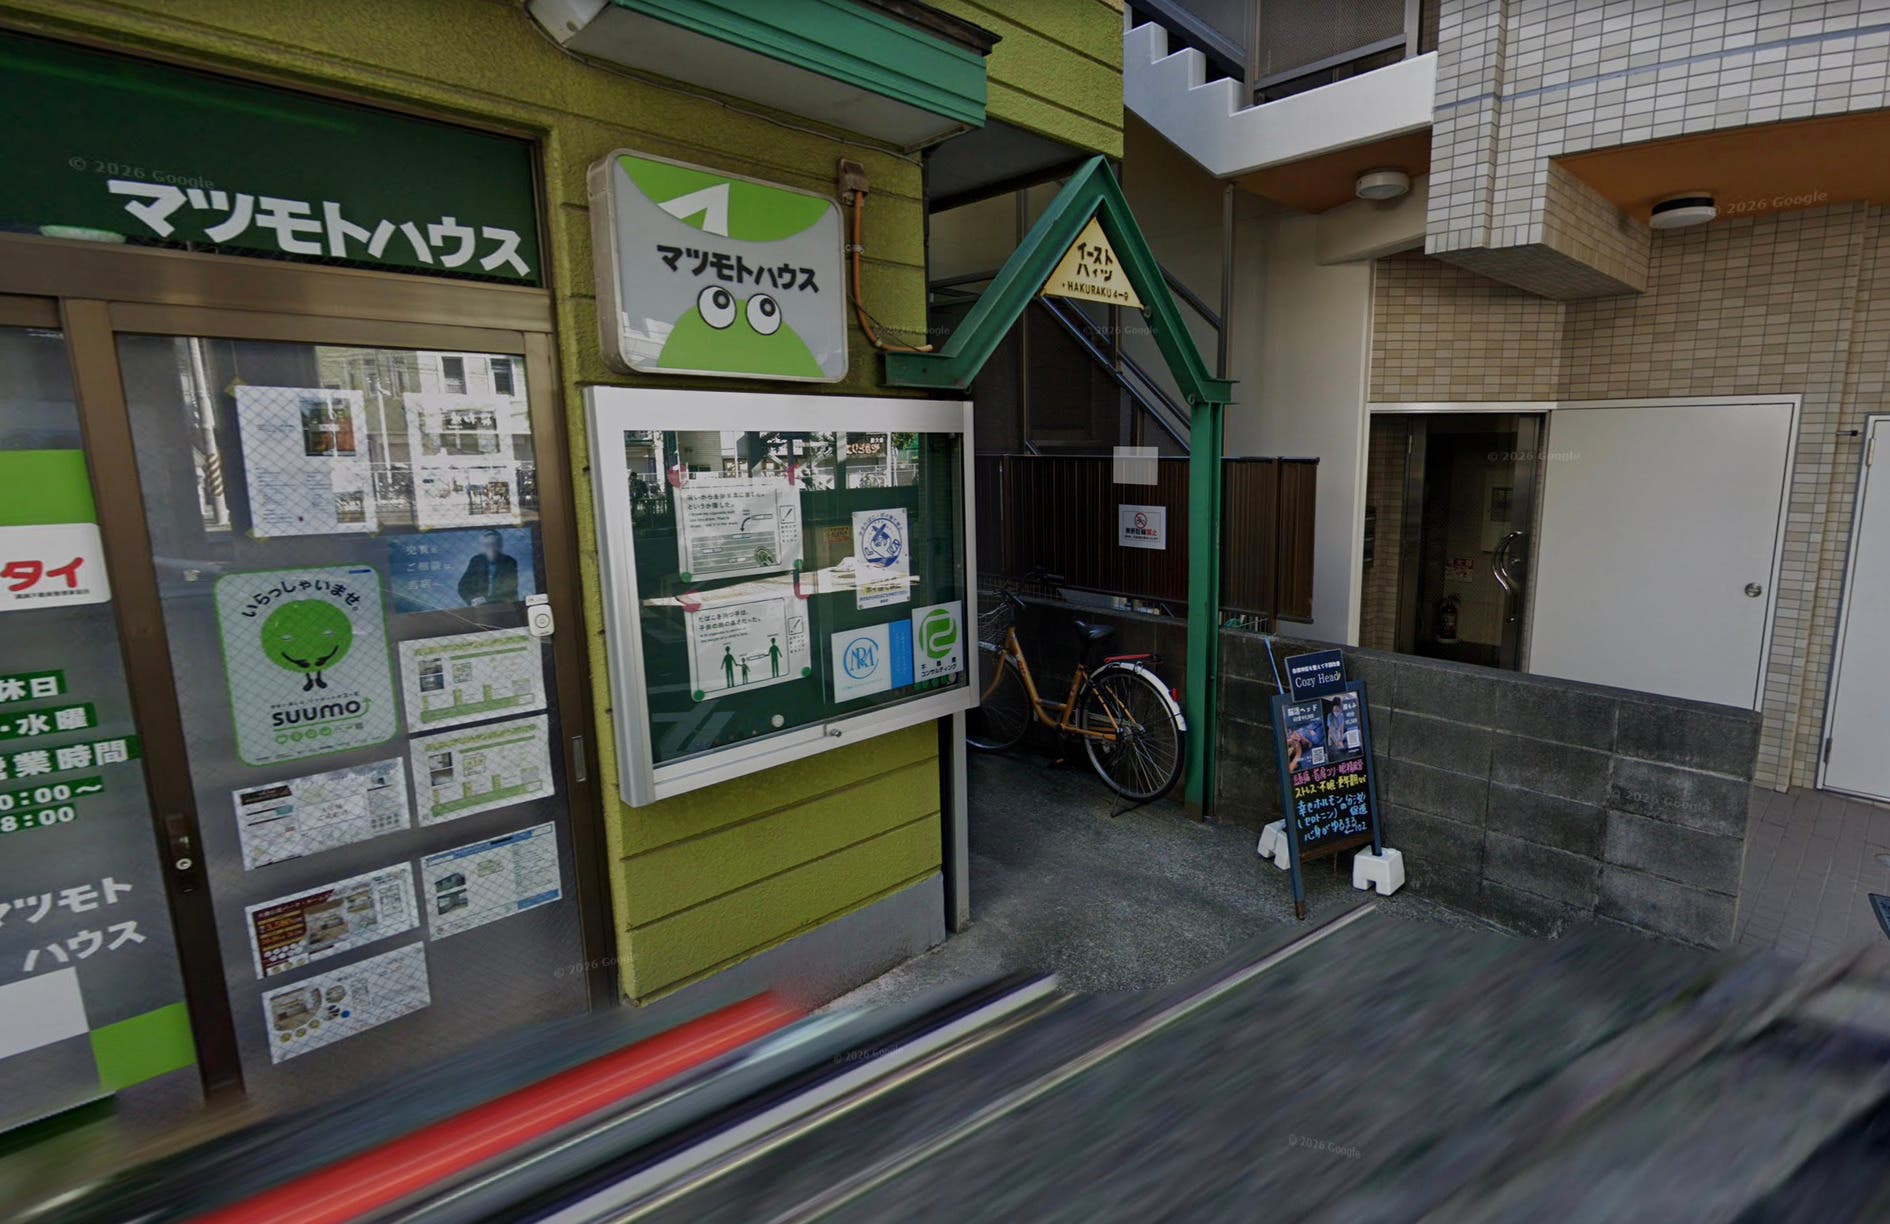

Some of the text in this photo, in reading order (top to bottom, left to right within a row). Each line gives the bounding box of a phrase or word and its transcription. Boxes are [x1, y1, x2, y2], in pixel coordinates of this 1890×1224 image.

[106, 178, 530, 277] マツモトハウス
[656, 244, 820, 294] マツモトハウス
[1076, 242, 1113, 266] イースト
[1067, 281, 1112, 298] HAKURAKU
[0, 556, 84, 592] タイ
[242, 579, 361, 618] いらっしゃいませ。
[1295, 676, 1316, 688] Cozy
[23, 920, 147, 972] ハウス
